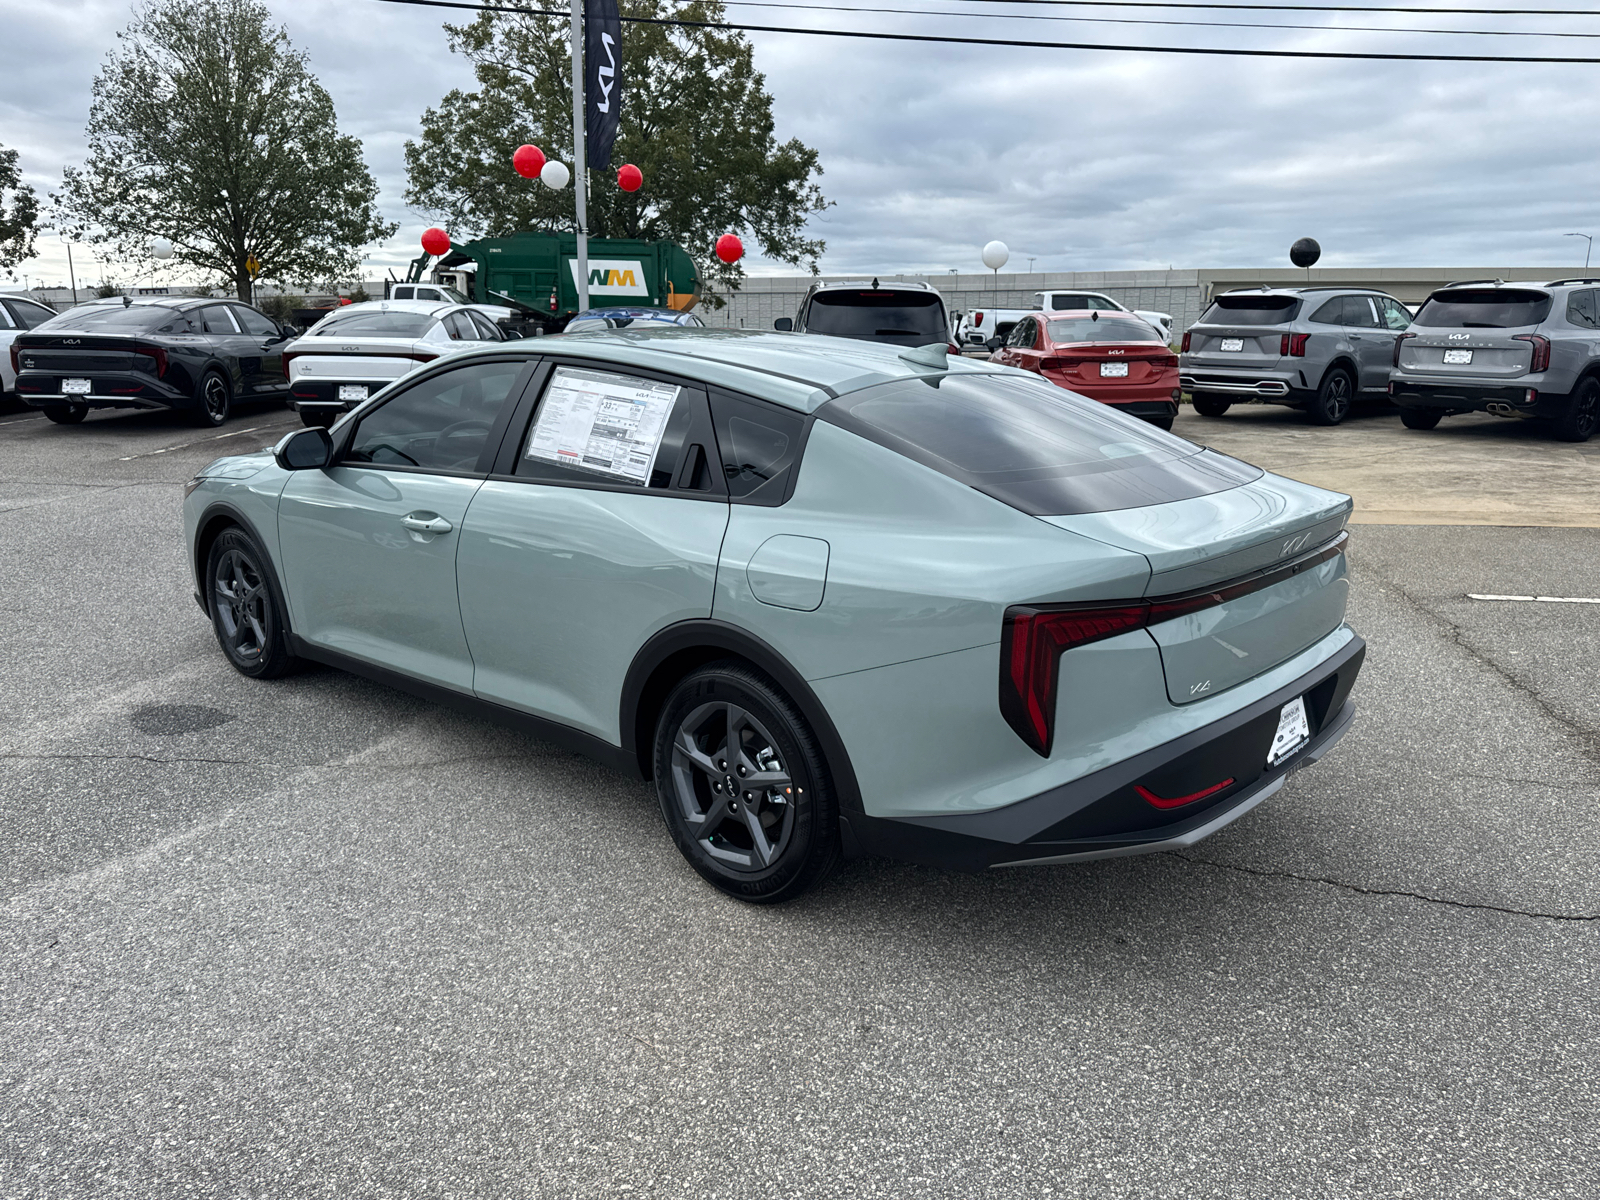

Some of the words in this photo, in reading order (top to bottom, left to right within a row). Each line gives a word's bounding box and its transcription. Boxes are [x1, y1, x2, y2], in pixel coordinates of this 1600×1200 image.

[597, 32, 615, 113] KIA
[588, 269, 636, 286] WM
[1278, 532, 1312, 557] KIA
[727, 775, 736, 797] KIA
[740, 867, 790, 894] KUMHO
